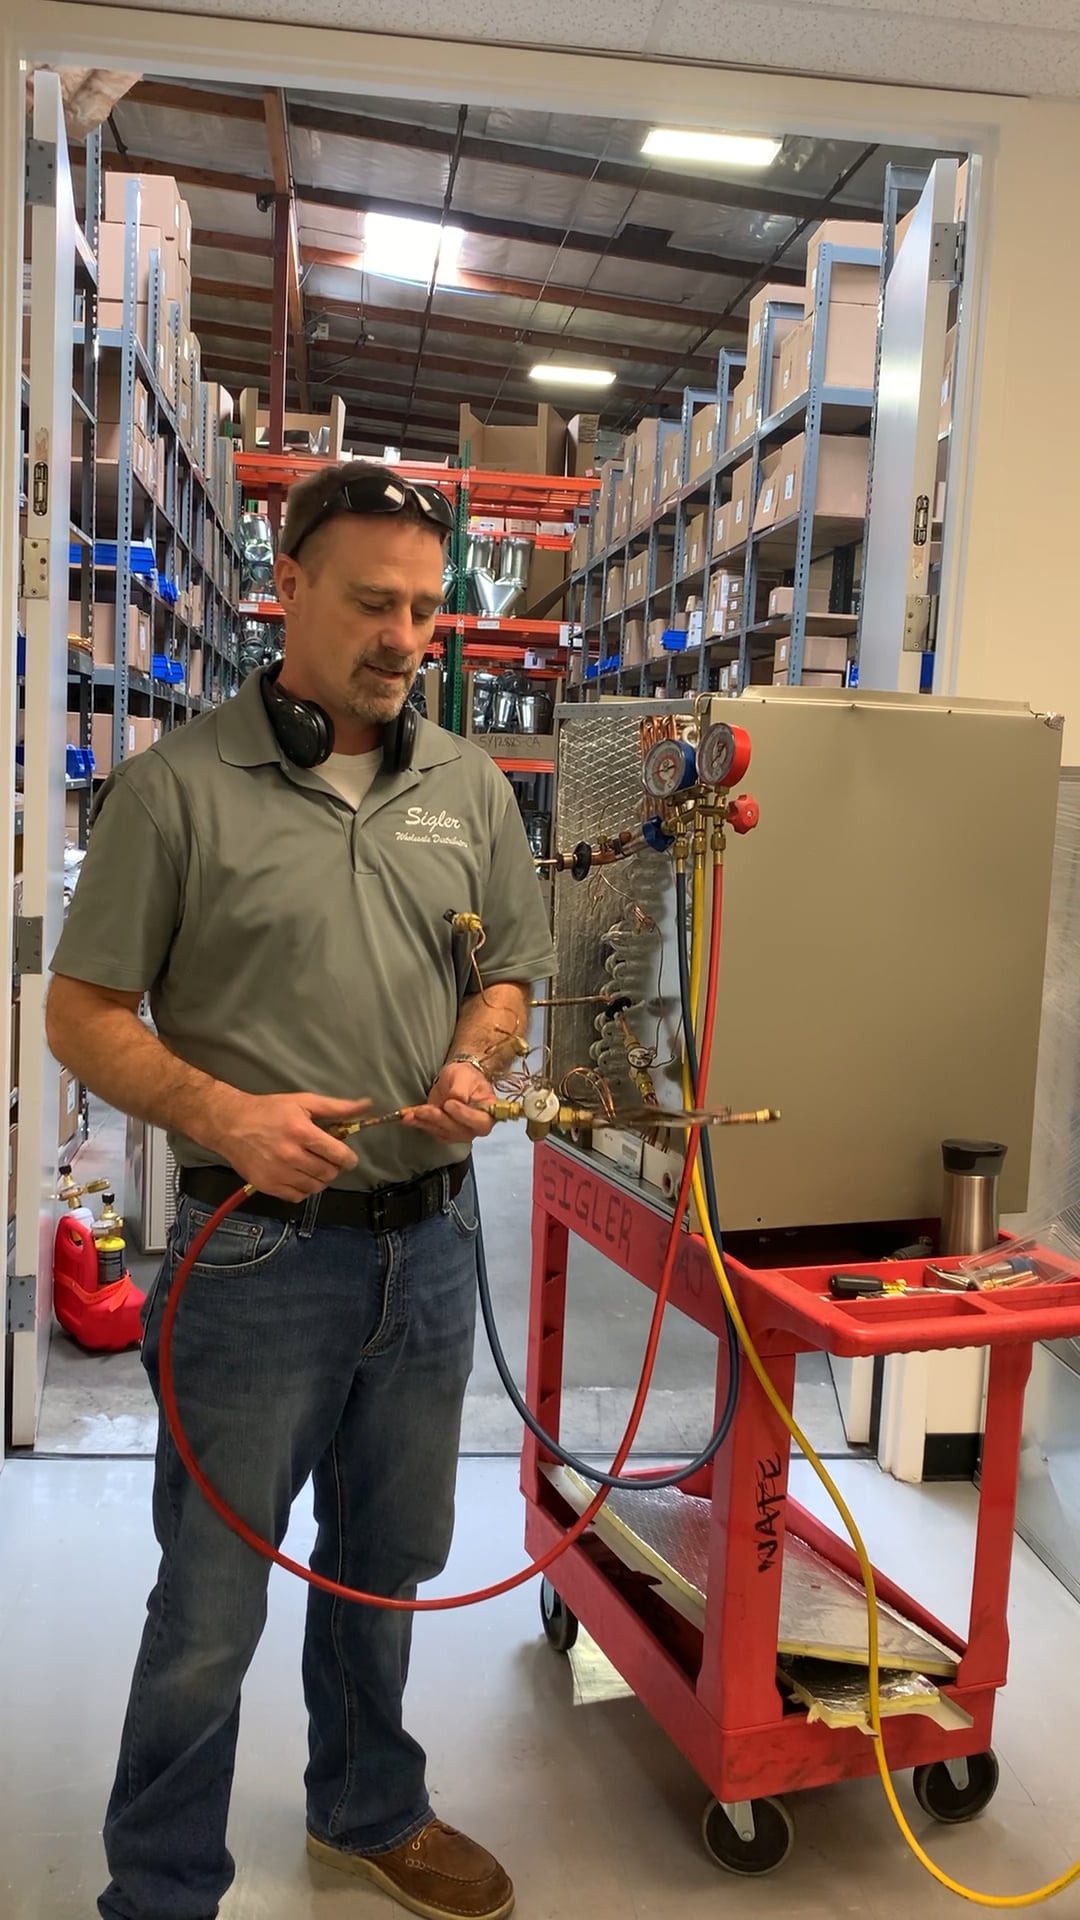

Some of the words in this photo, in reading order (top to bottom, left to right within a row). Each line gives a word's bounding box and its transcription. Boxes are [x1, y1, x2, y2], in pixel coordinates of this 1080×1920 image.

[405, 807, 461, 833] Sigler
[541, 1159, 633, 1264] SIGLER
[755, 1452, 786, 1573] NATE
